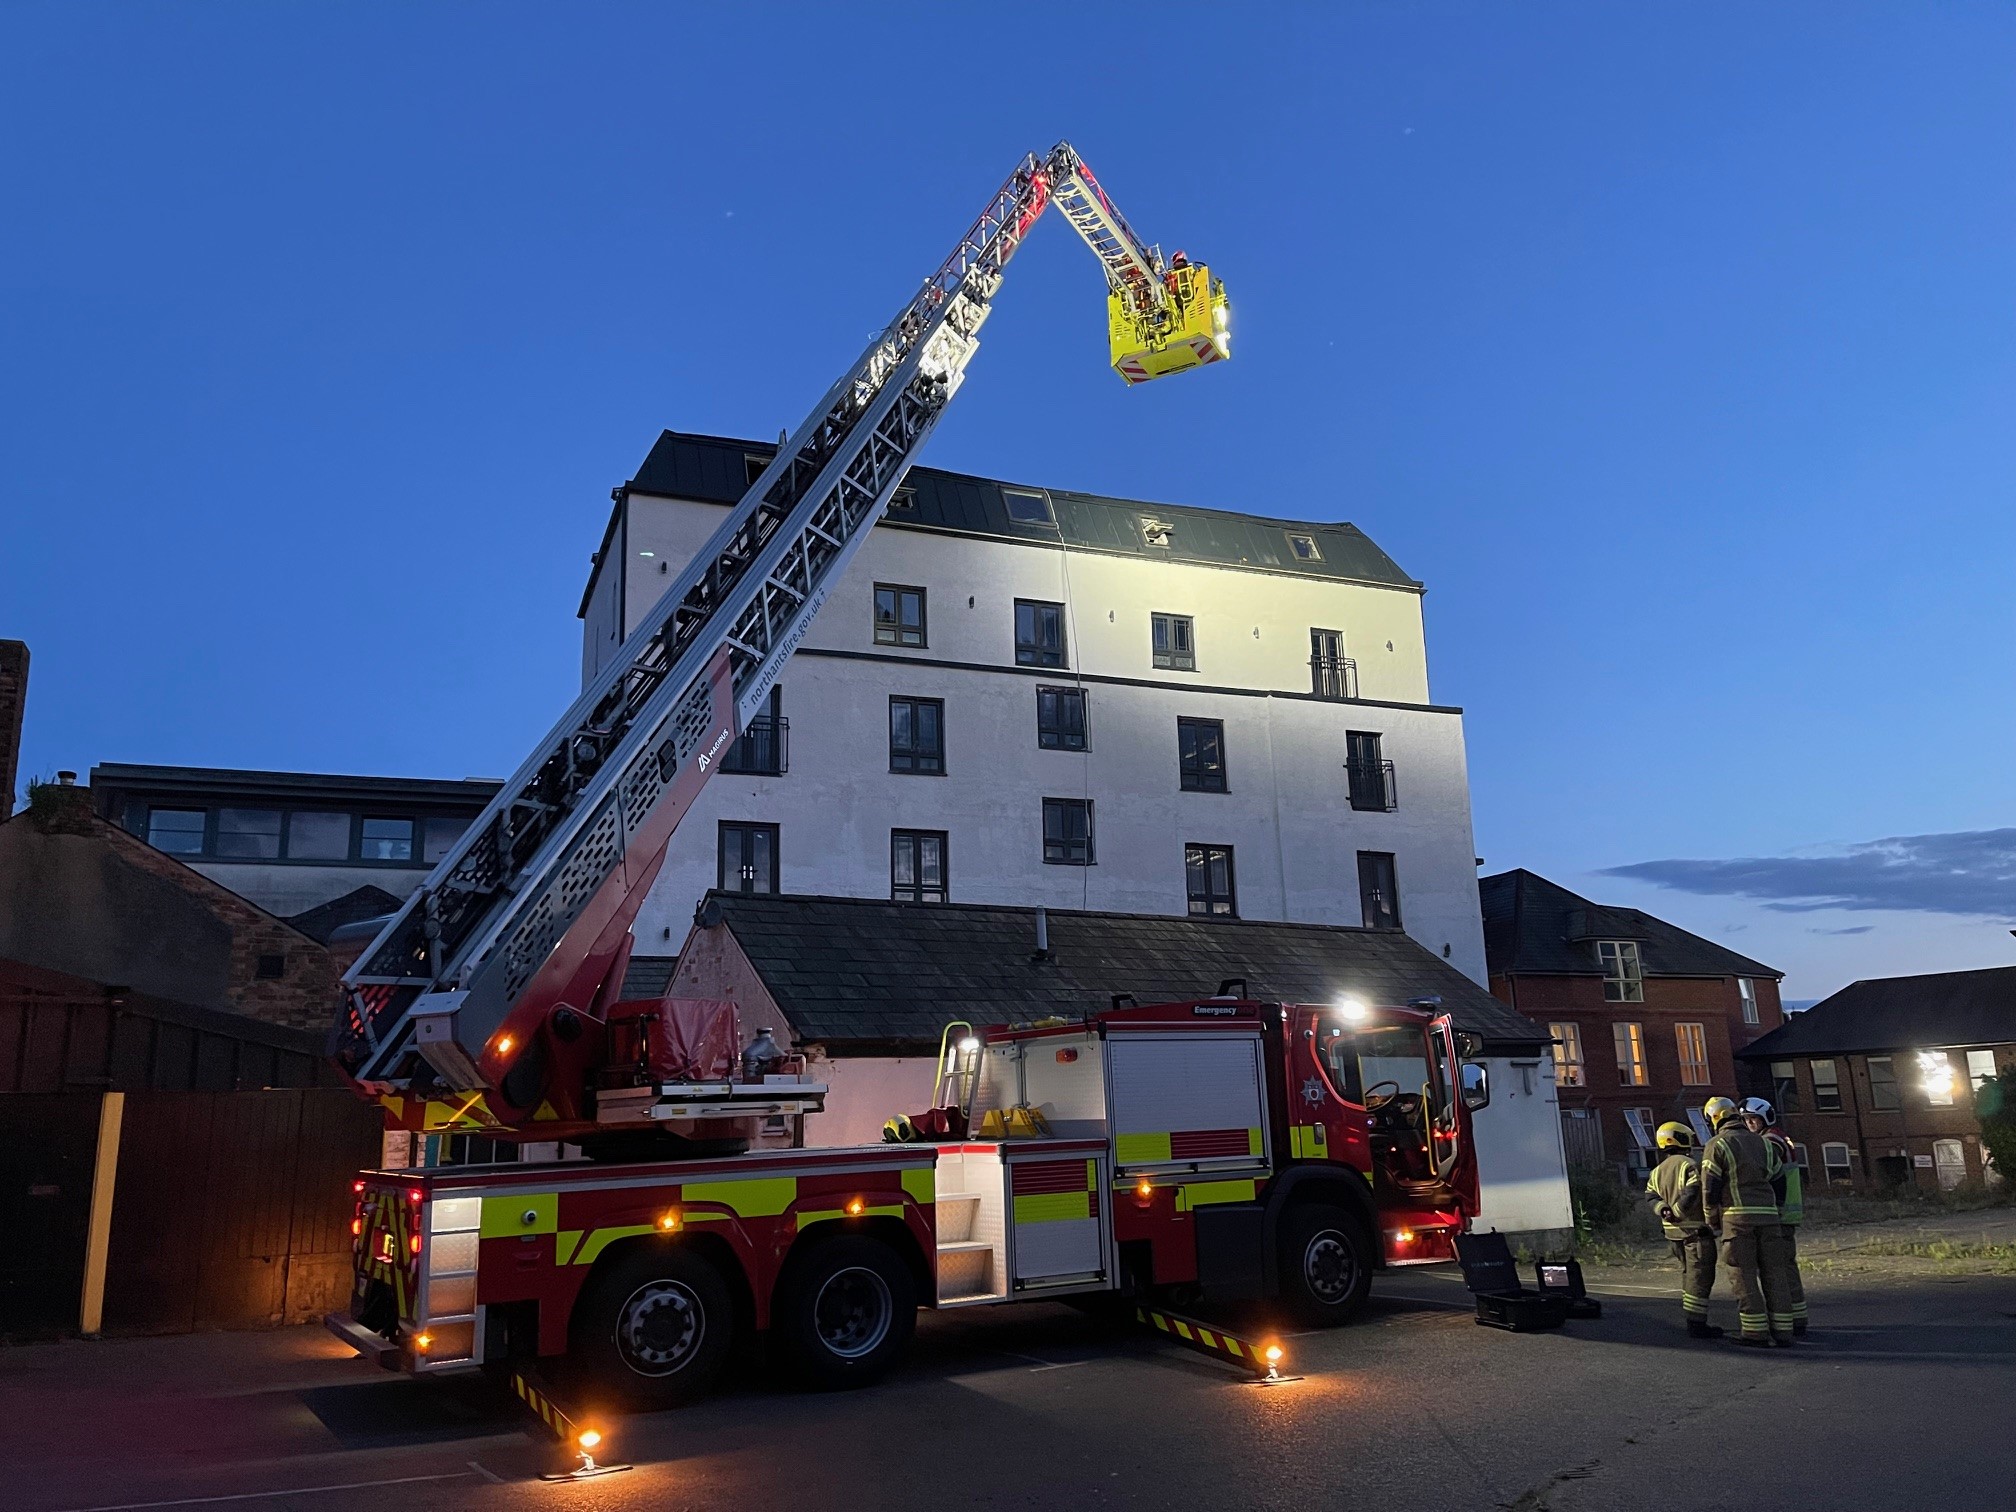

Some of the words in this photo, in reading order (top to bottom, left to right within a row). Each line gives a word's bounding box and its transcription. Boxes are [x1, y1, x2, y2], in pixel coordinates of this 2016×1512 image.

[750, 597, 823, 705] northantsfire.gov.uk
[708, 728, 729, 758] MAGIRUS
[1194, 1005, 1237, 1016] Emergency
